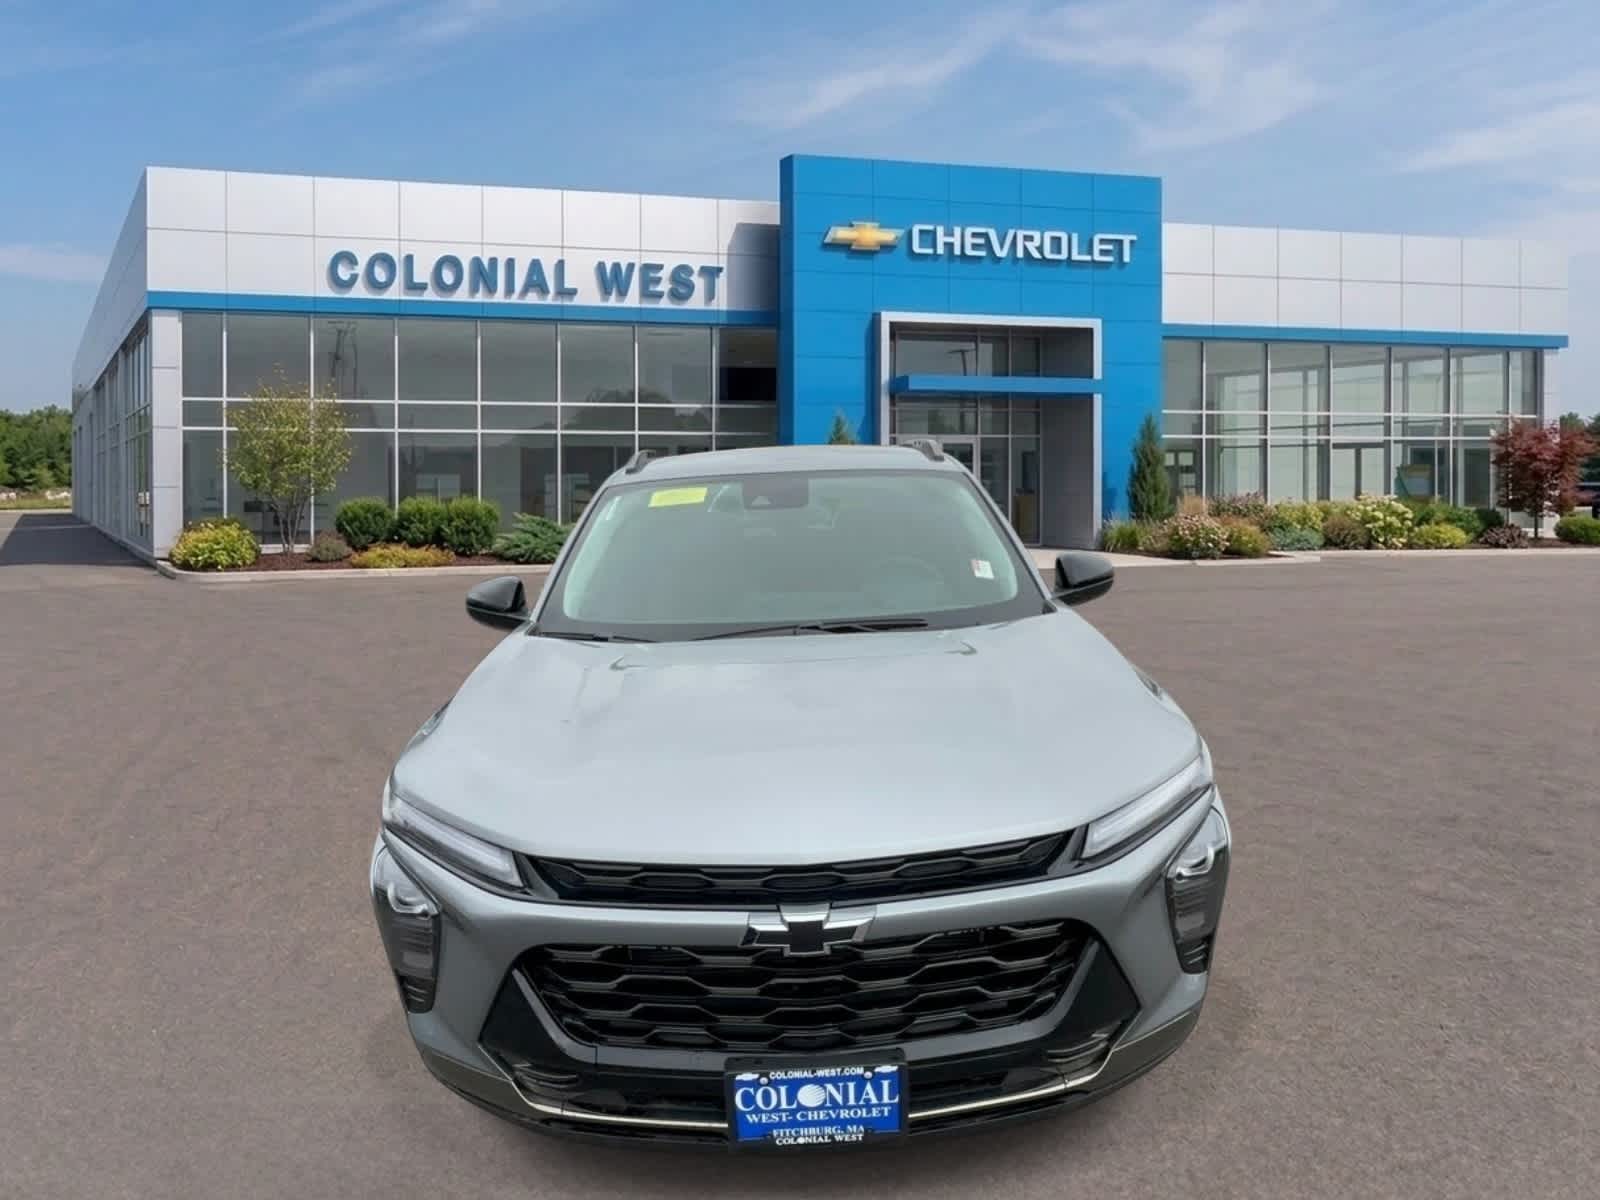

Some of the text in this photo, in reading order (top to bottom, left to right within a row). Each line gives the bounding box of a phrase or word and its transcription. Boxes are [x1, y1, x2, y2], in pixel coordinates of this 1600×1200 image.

[911, 223, 1137, 263] CHEVROLET
[327, 250, 724, 304] COLONIAL WEST
[769, 1067, 865, 1080] COLONIAL-WEST.COM
[735, 1080, 899, 1112] COLONIAL
[796, 1106, 892, 1121] CHEVROLET
[846, 1125, 865, 1134] MA
[776, 1133, 864, 1146] COLONIAL WEST
